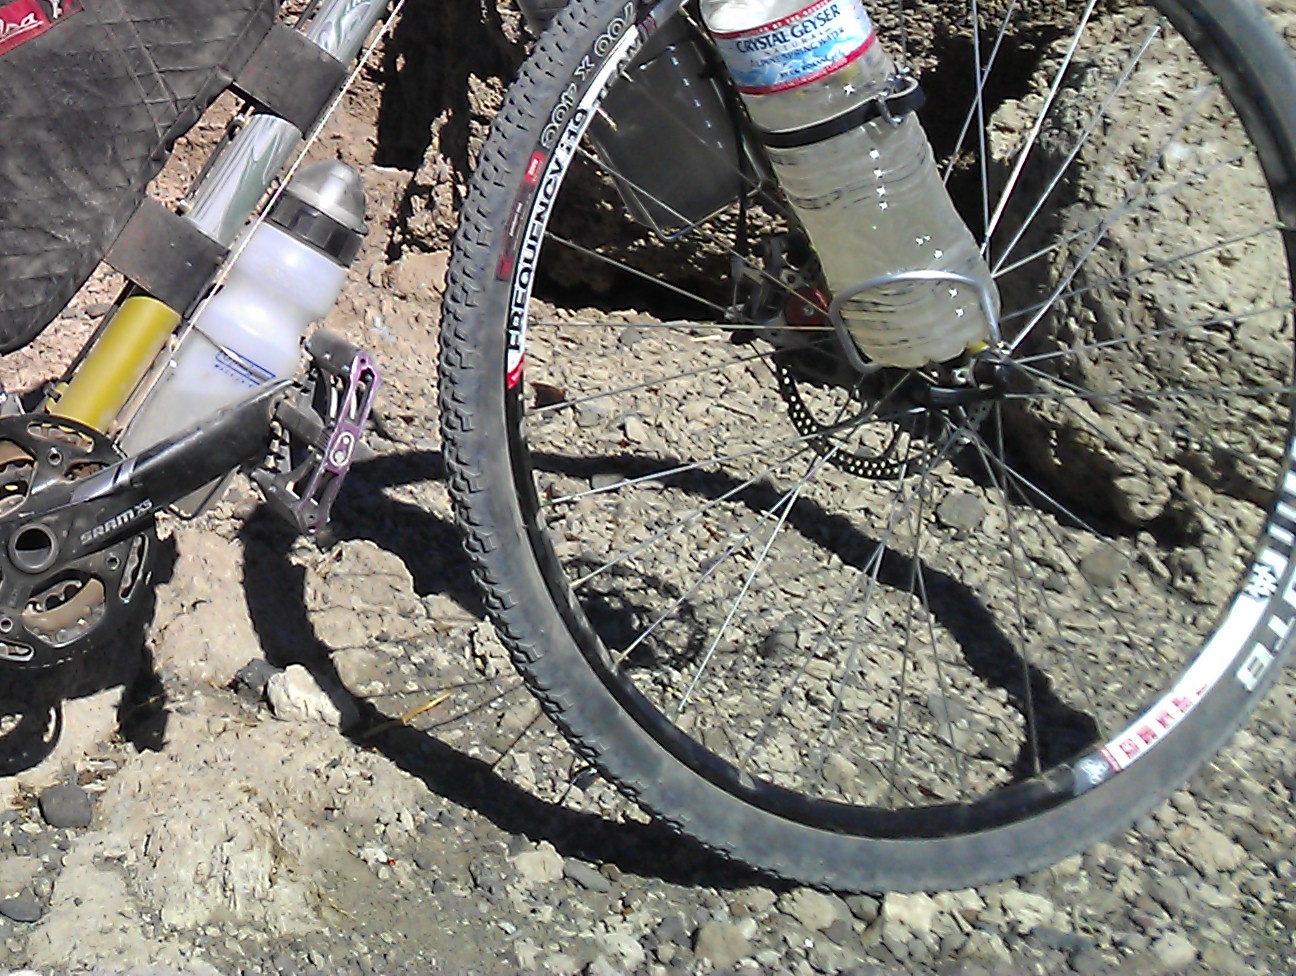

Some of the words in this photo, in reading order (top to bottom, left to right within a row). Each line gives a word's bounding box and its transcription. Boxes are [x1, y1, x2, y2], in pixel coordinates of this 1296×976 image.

[736, 32, 791, 54] CRYSTAL
[790, 3, 841, 39] GEYSER
[508, 156, 564, 353] FREQUENCY
[80, 509, 135, 544] SRAM
